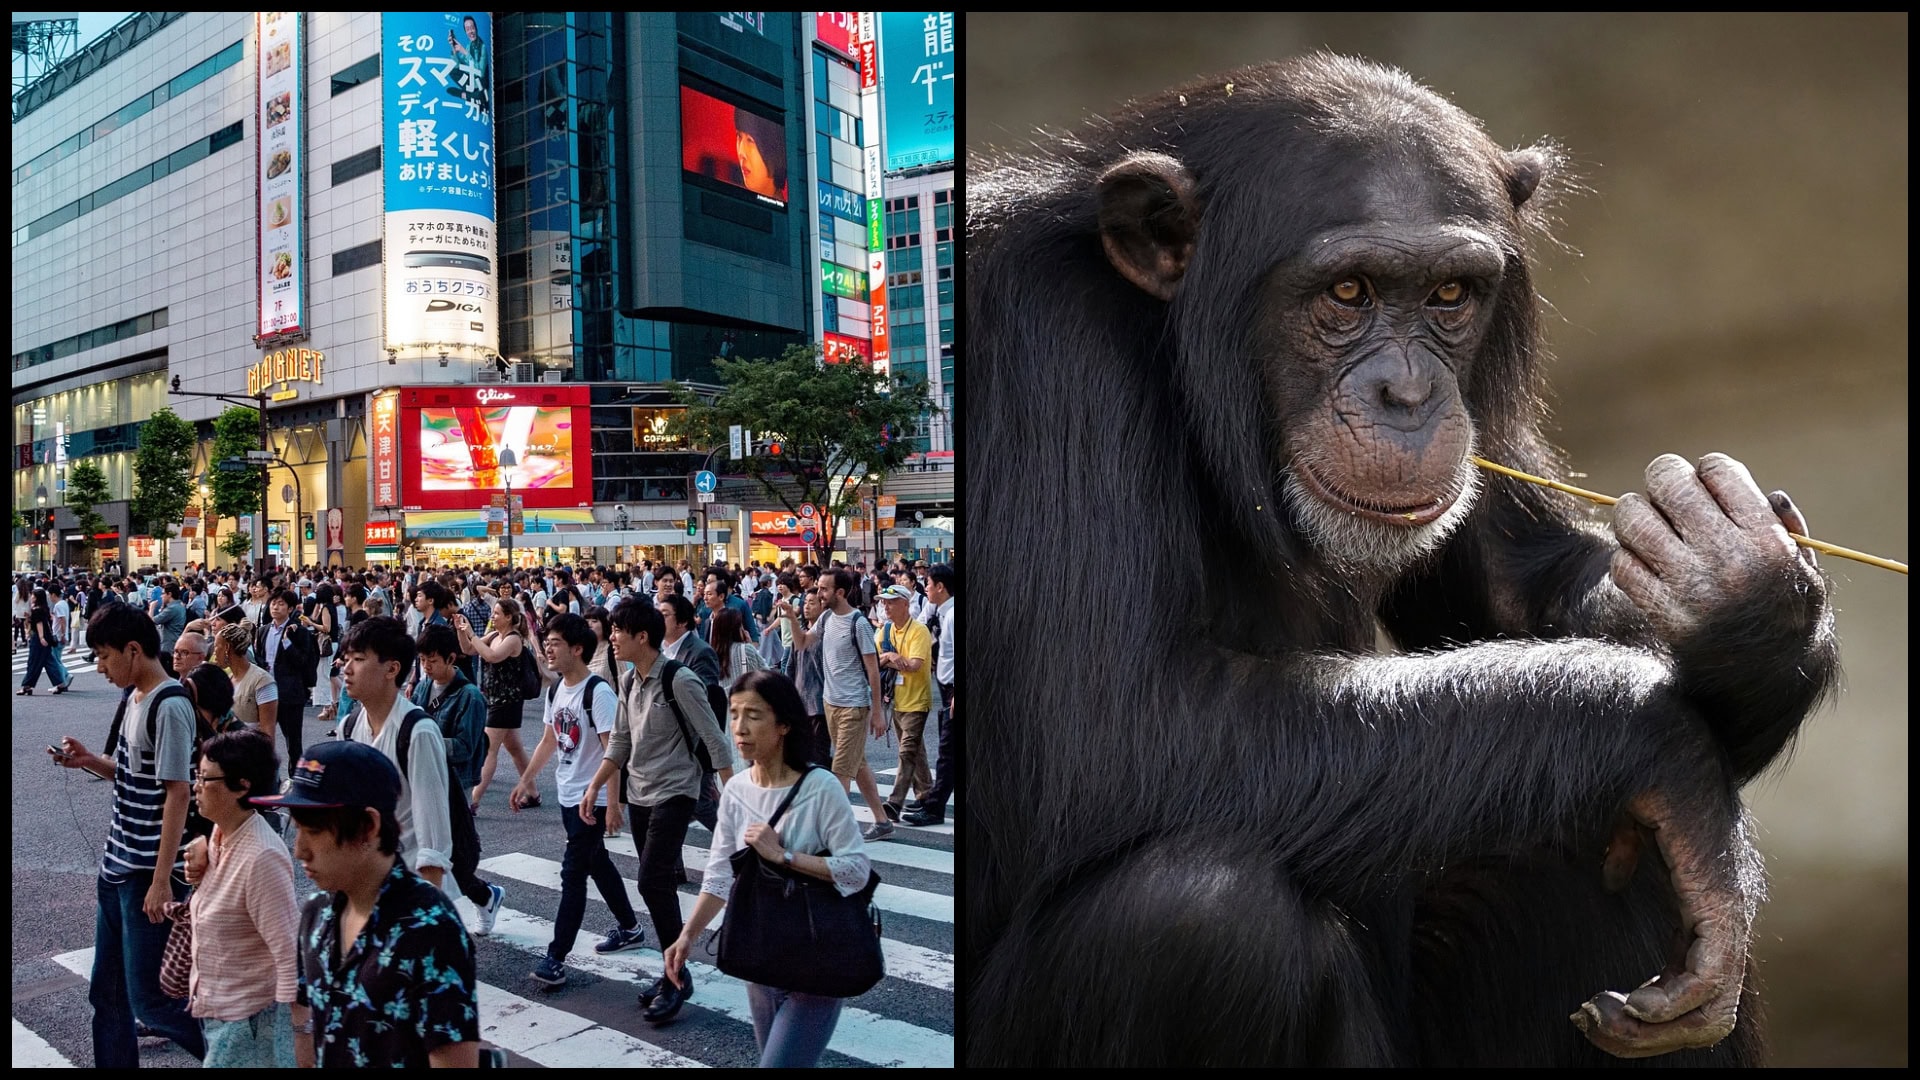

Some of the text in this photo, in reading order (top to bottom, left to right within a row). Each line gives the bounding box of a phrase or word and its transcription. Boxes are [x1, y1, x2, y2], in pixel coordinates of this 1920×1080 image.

[398, 35, 434, 52] その
[864, 53, 875, 87] アイフル
[398, 91, 490, 125] ディーガが
[398, 119, 490, 167] 軽くして
[399, 161, 491, 190] あげましょう!
[406, 280, 491, 299] おうちクラウド
[275, 300, 282, 312] 7F
[425, 299, 482, 313] DIGA
[873, 305, 885, 336] アコム
[248, 348, 323, 397] MAGNET
[476, 389, 516, 405] Glico
[378, 413, 392, 503] 天津甘栗
[435, 547, 453, 555] TAX
[455, 547, 475, 555] Free
